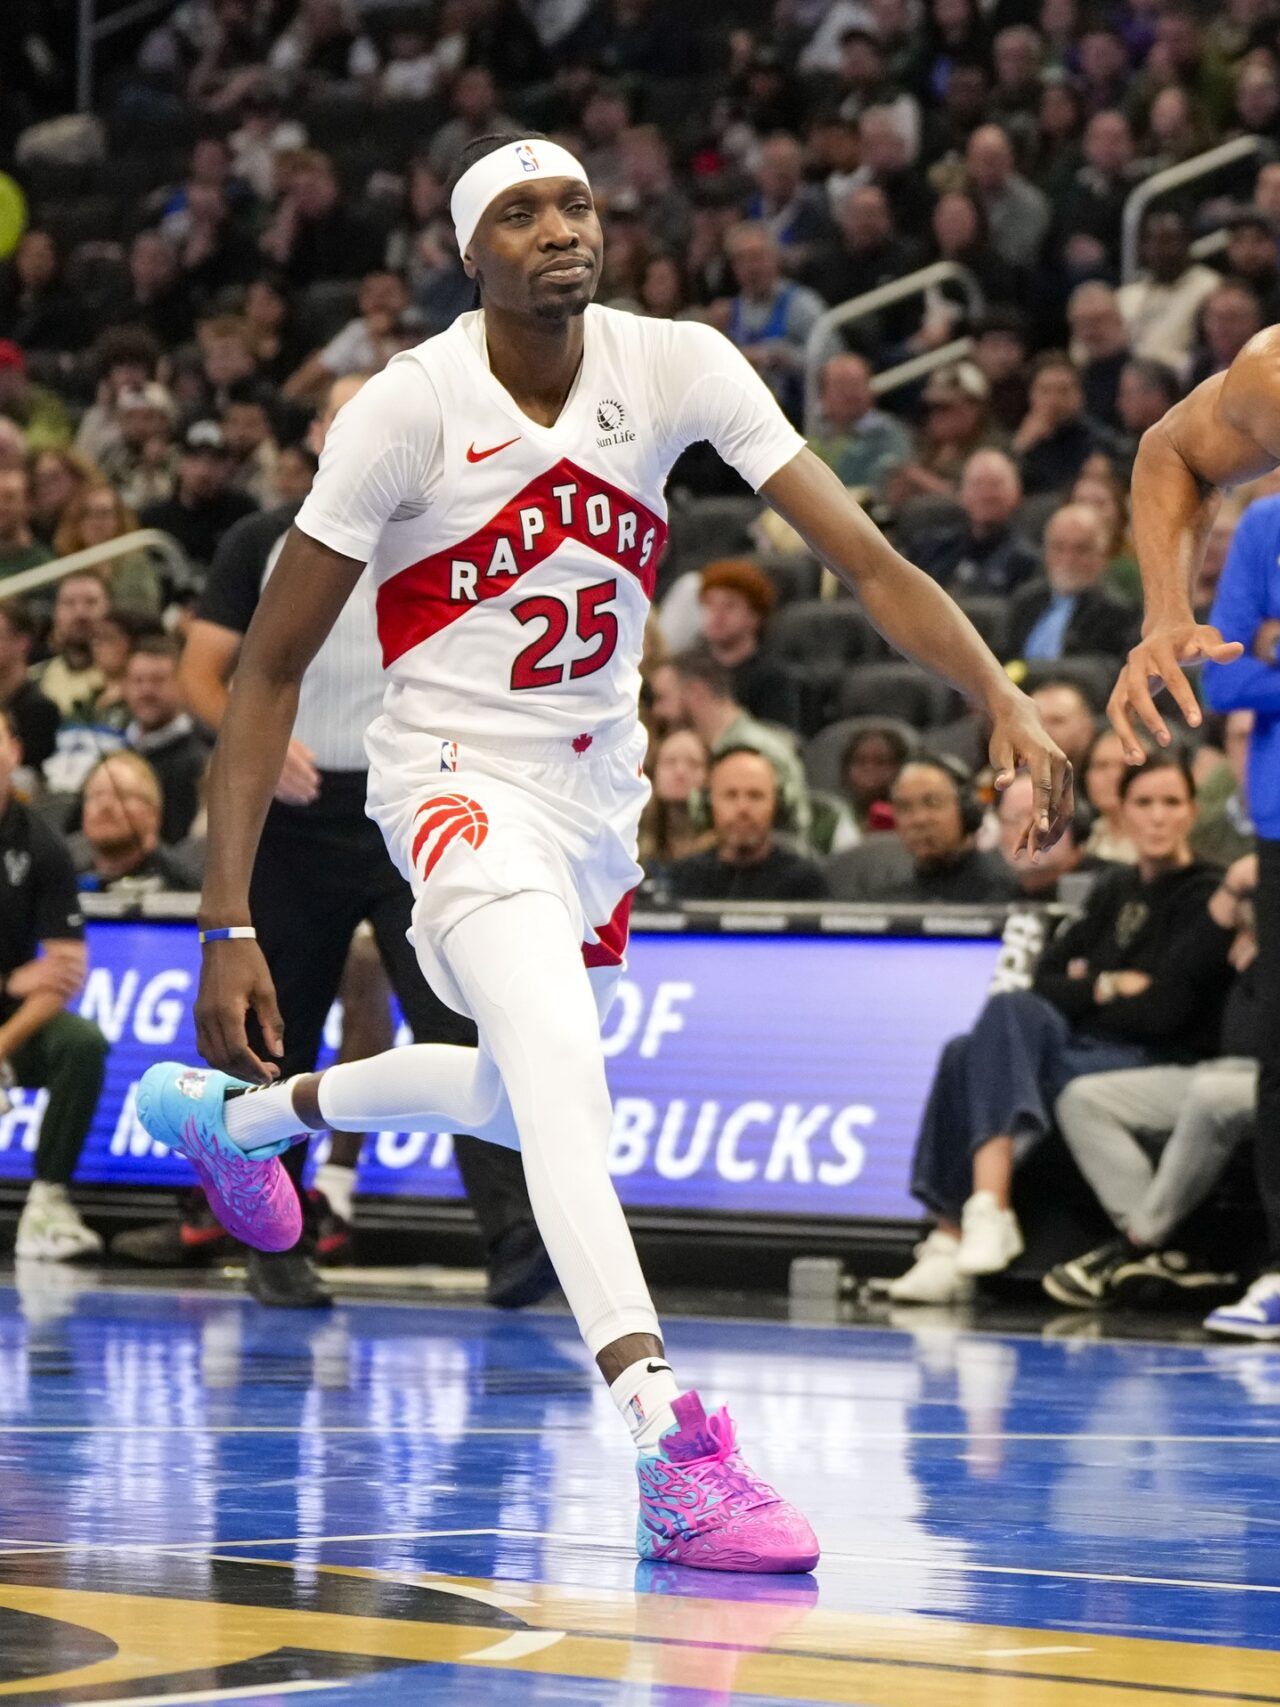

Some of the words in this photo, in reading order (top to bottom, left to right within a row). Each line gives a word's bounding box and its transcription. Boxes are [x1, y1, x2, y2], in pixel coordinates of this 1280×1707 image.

[613, 430, 636, 444] Life
[450, 483, 656, 601] RAPTORS
[510, 578, 618, 690] 25
[605, 1096, 877, 1186] BUCKS
